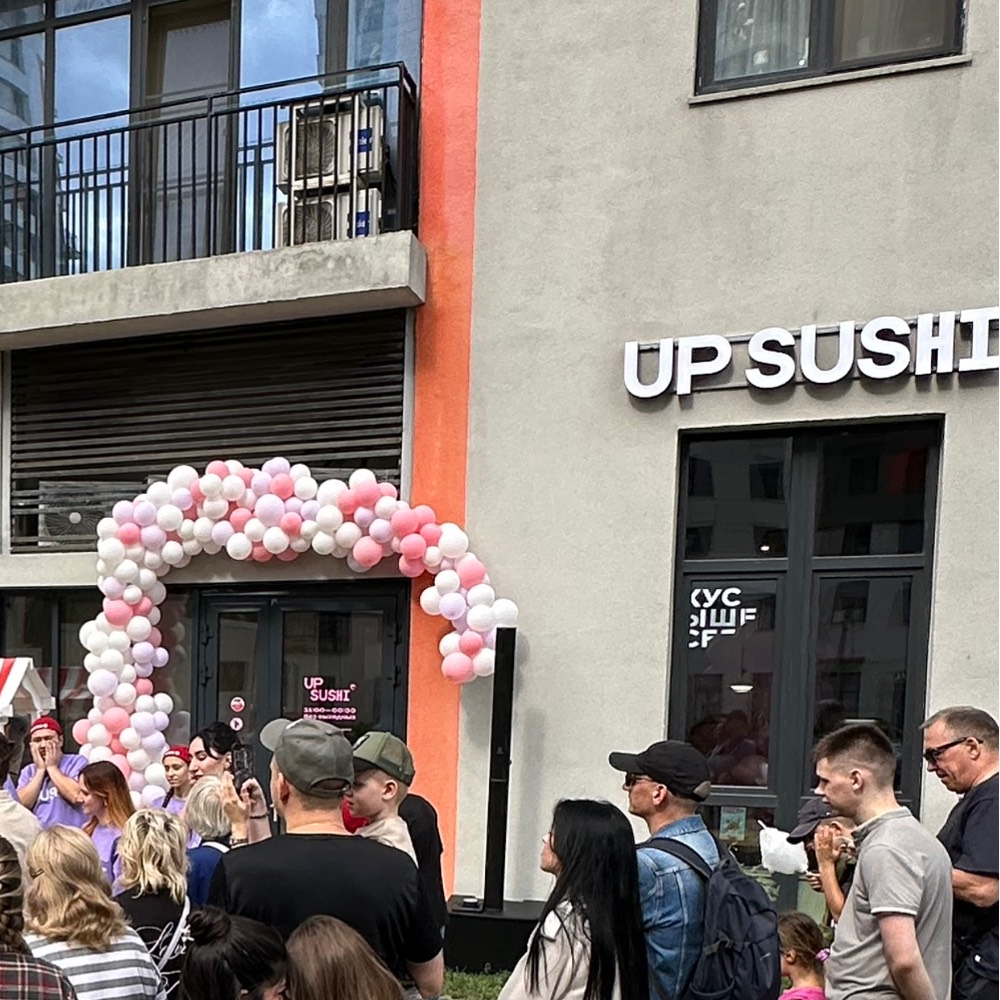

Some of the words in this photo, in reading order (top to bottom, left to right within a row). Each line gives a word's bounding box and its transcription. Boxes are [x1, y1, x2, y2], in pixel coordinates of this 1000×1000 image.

[623, 334, 732, 398] UP
[745, 307, 1000, 389] SUSHI
[303, 677, 324, 690] UP
[310, 689, 350, 702] SUSHI
